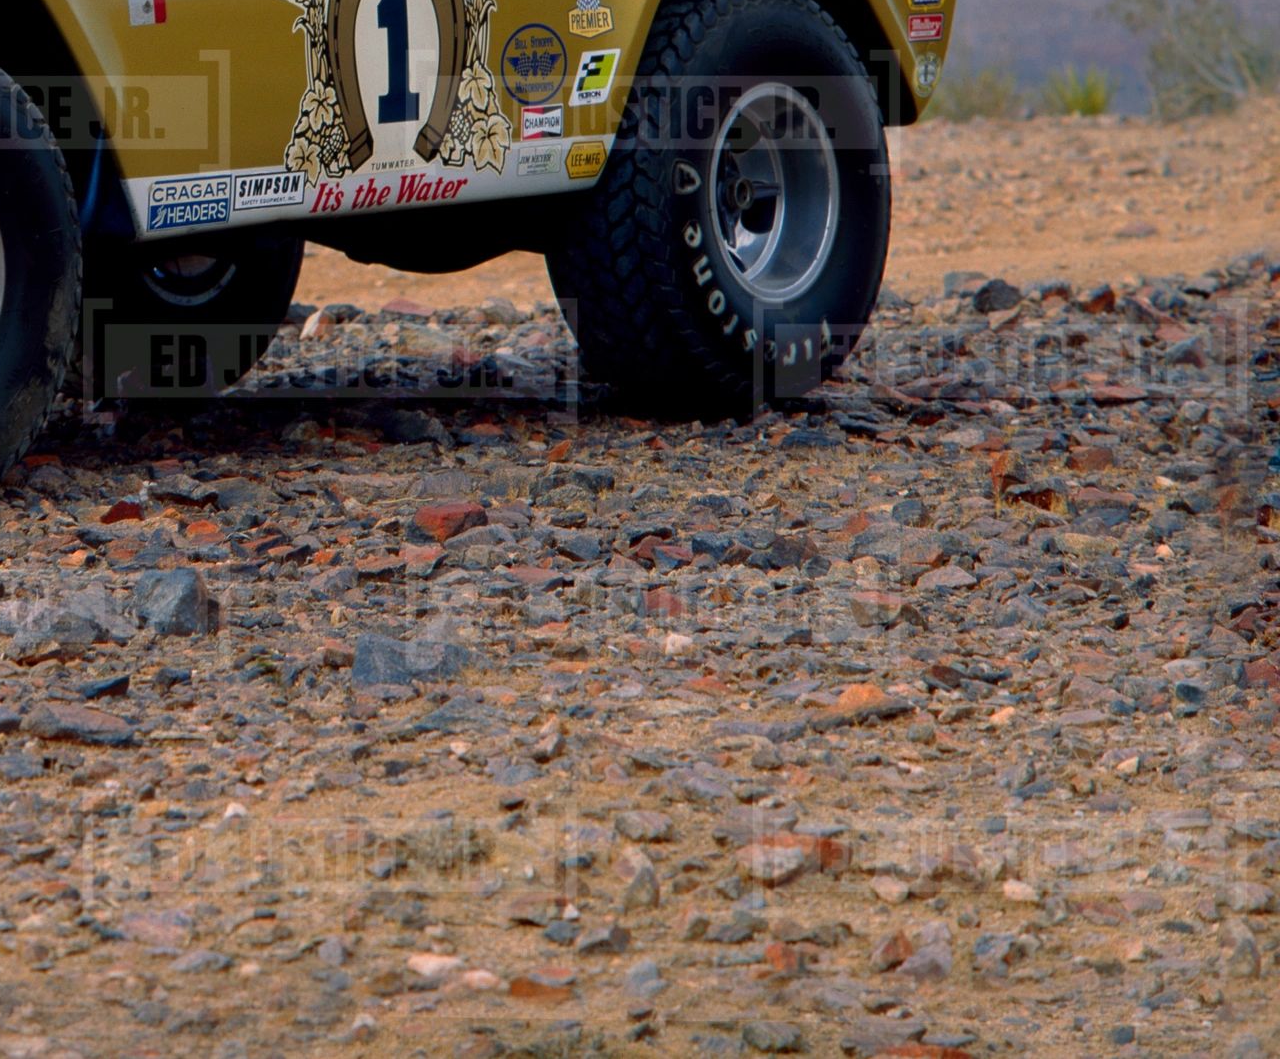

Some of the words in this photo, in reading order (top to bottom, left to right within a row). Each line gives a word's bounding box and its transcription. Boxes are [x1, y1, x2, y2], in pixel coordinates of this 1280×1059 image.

[571, 12, 609, 29] PREMIER
[525, 116, 560, 129] CHAMPION
[371, 159, 416, 171] TUMWATER
[152, 181, 228, 203] CRAGAR
[239, 175, 301, 197] SIMPSON
[309, 181, 345, 214] It's
[351, 179, 388, 210] the
[395, 172, 468, 205] Water
[241, 198, 259, 206] SAFETY
[167, 201, 226, 224] HEADERS
